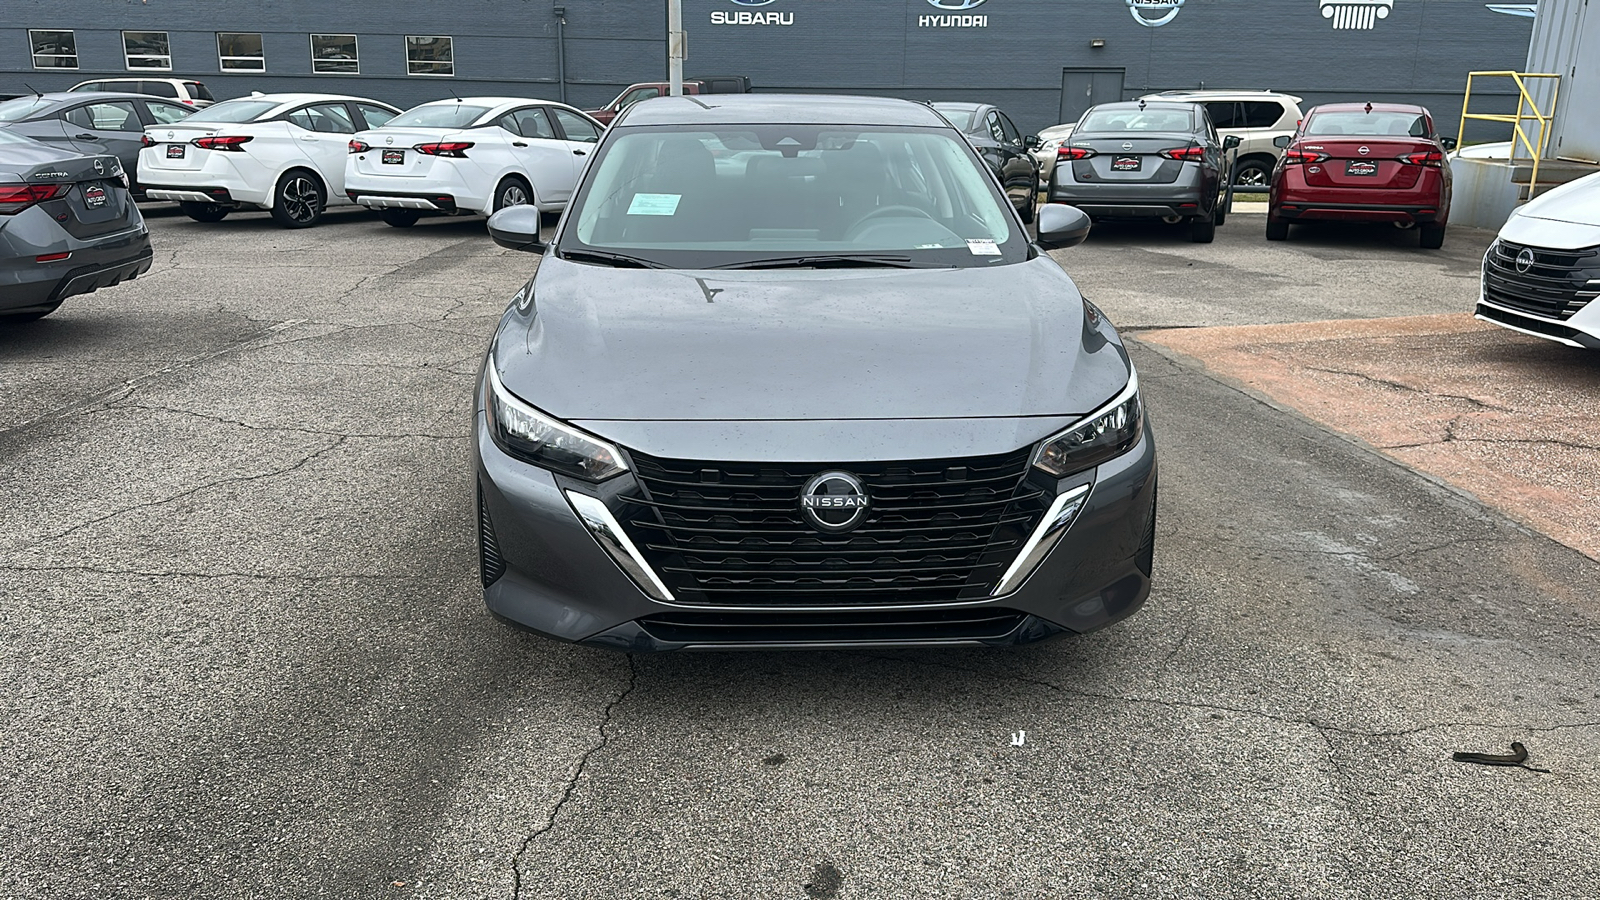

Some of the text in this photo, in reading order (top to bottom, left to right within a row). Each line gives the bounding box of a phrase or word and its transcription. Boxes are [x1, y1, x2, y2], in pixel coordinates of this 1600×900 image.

[710, 11, 794, 25] SUBARU
[918, 15, 988, 27] HYUNDAI
[803, 497, 867, 507] NISSAN
